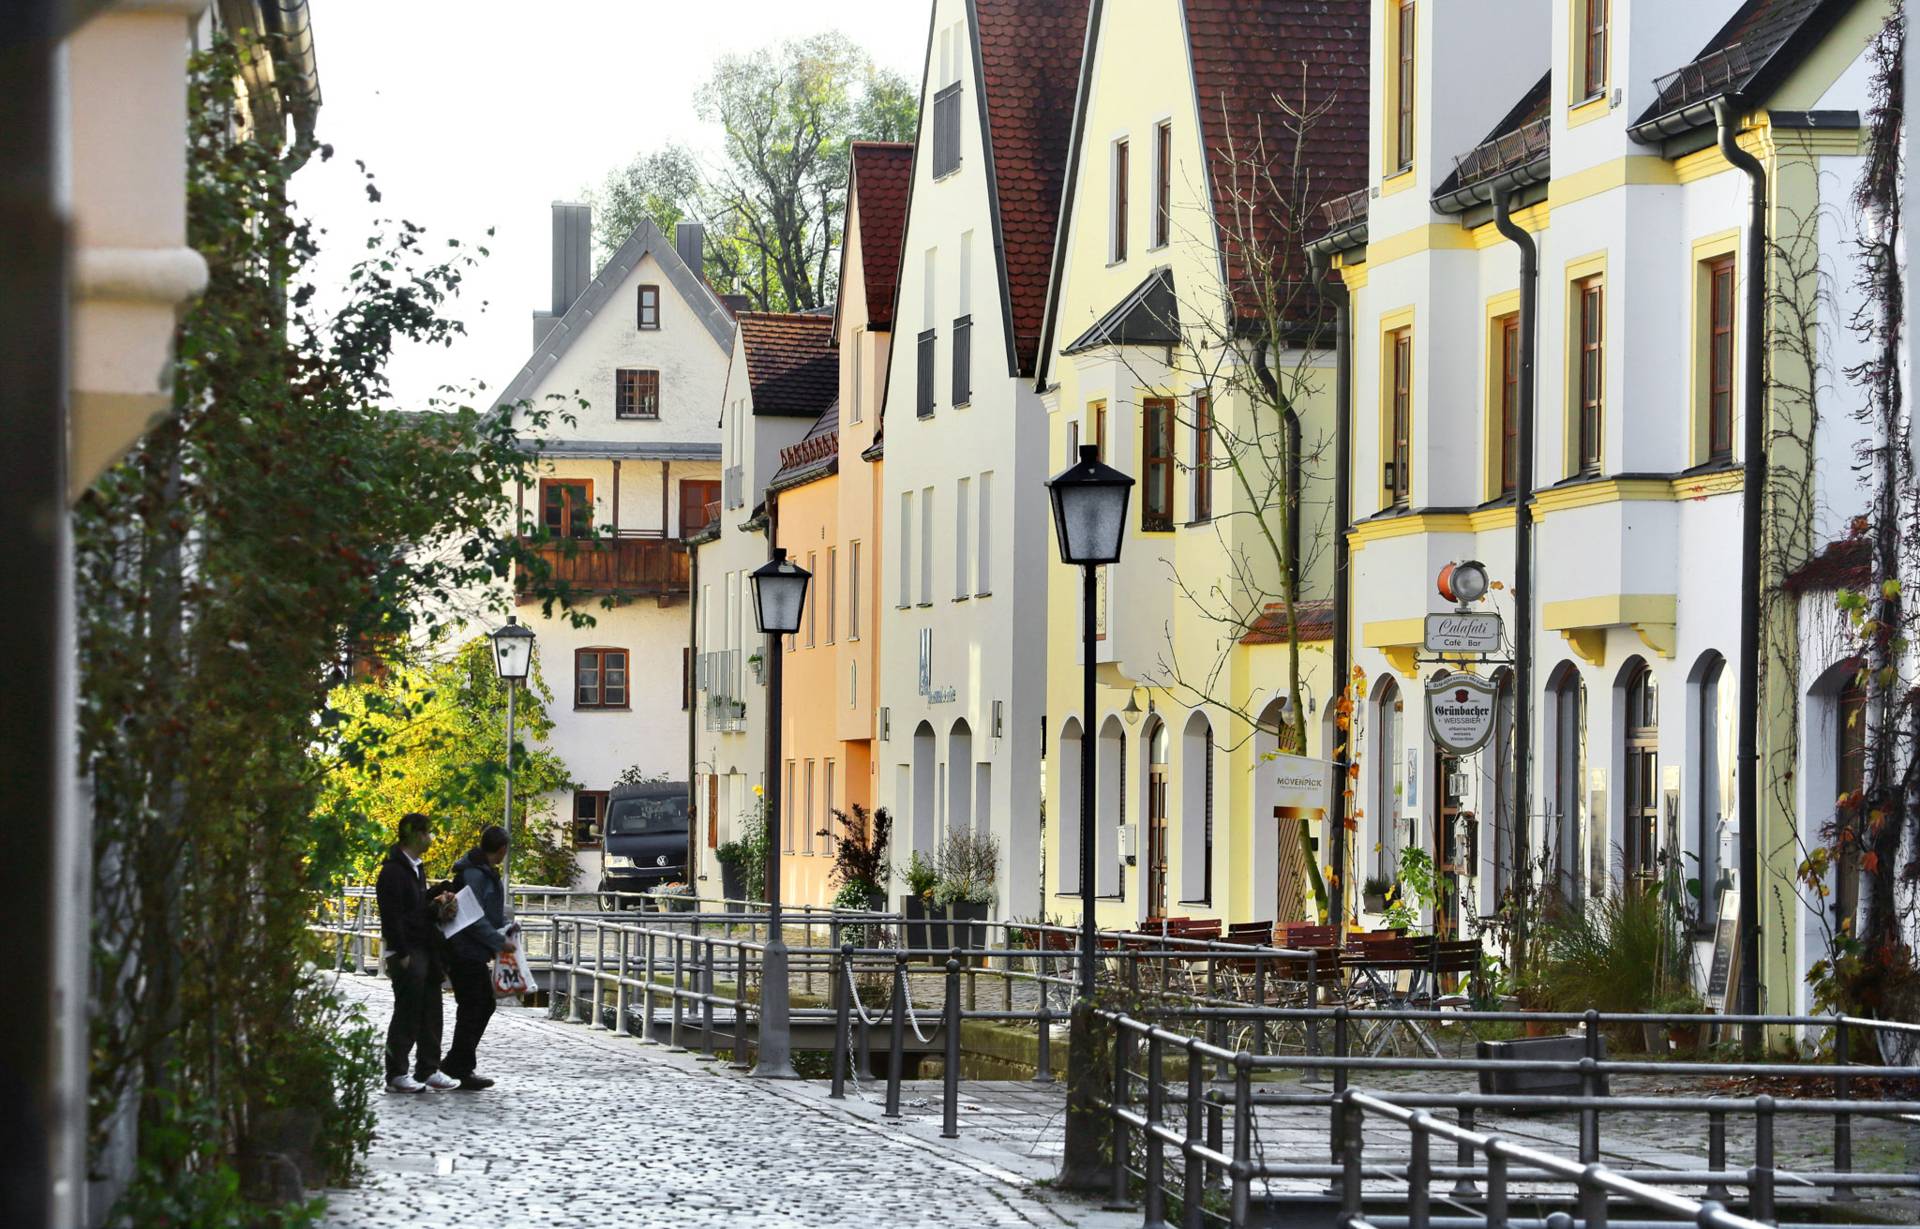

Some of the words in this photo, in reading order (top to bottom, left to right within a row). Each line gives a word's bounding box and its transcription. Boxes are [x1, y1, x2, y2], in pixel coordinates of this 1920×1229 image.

[1439, 618, 1488, 638] Calafati
[1444, 638, 1462, 647] Café
[1468, 639, 1481, 647] Bar
[1435, 705, 1490, 718] Grünbacher
